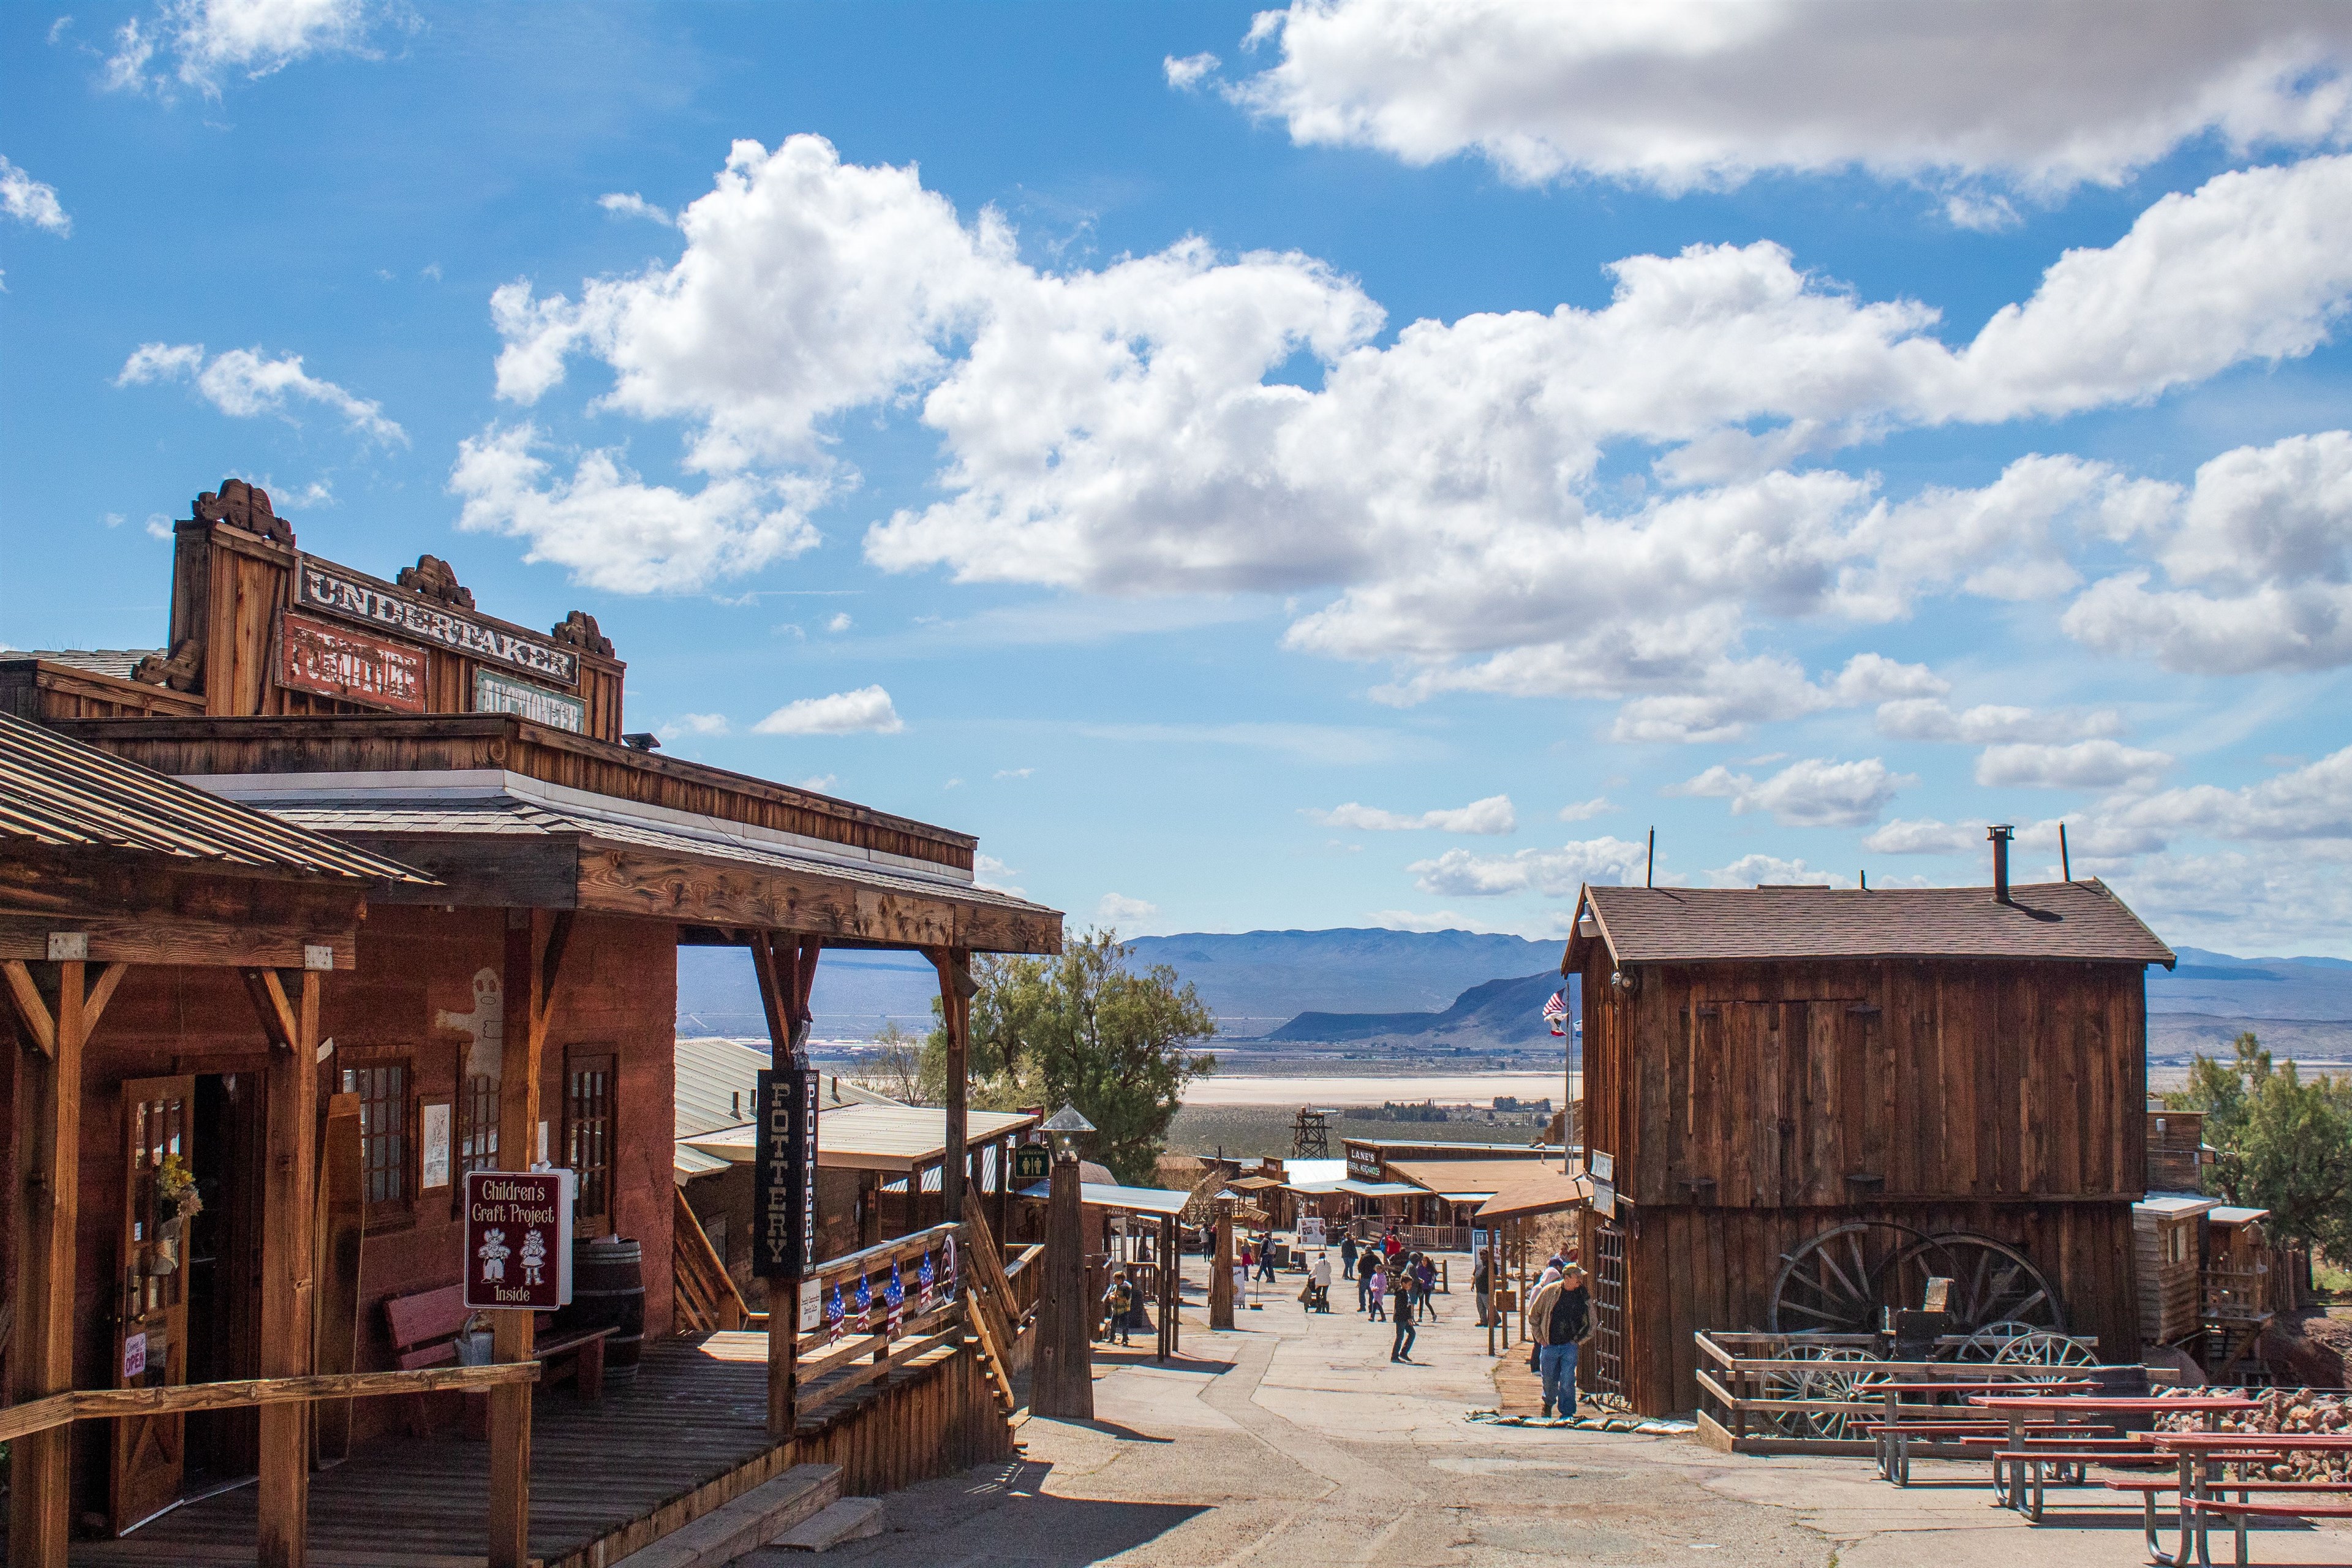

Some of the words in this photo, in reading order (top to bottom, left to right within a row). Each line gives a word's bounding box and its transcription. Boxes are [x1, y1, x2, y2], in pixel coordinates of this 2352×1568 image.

[307, 570, 570, 679] UNDERTAKER
[291, 626, 418, 703] FURNITURE
[484, 679, 578, 733] AUCTIONEER
[1351, 1149, 1375, 1163] LANE'S
[767, 1083, 791, 1263] POTTERY
[805, 1084, 815, 1263] POTTERY
[482, 1180, 545, 1202] Children's
[472, 1203, 506, 1222] Craft
[509, 1204, 554, 1227] Project
[1129, 1216, 1161, 1229] SALOO
[493, 1286, 530, 1302] Inside
[126, 1352, 145, 1373] OPEN
